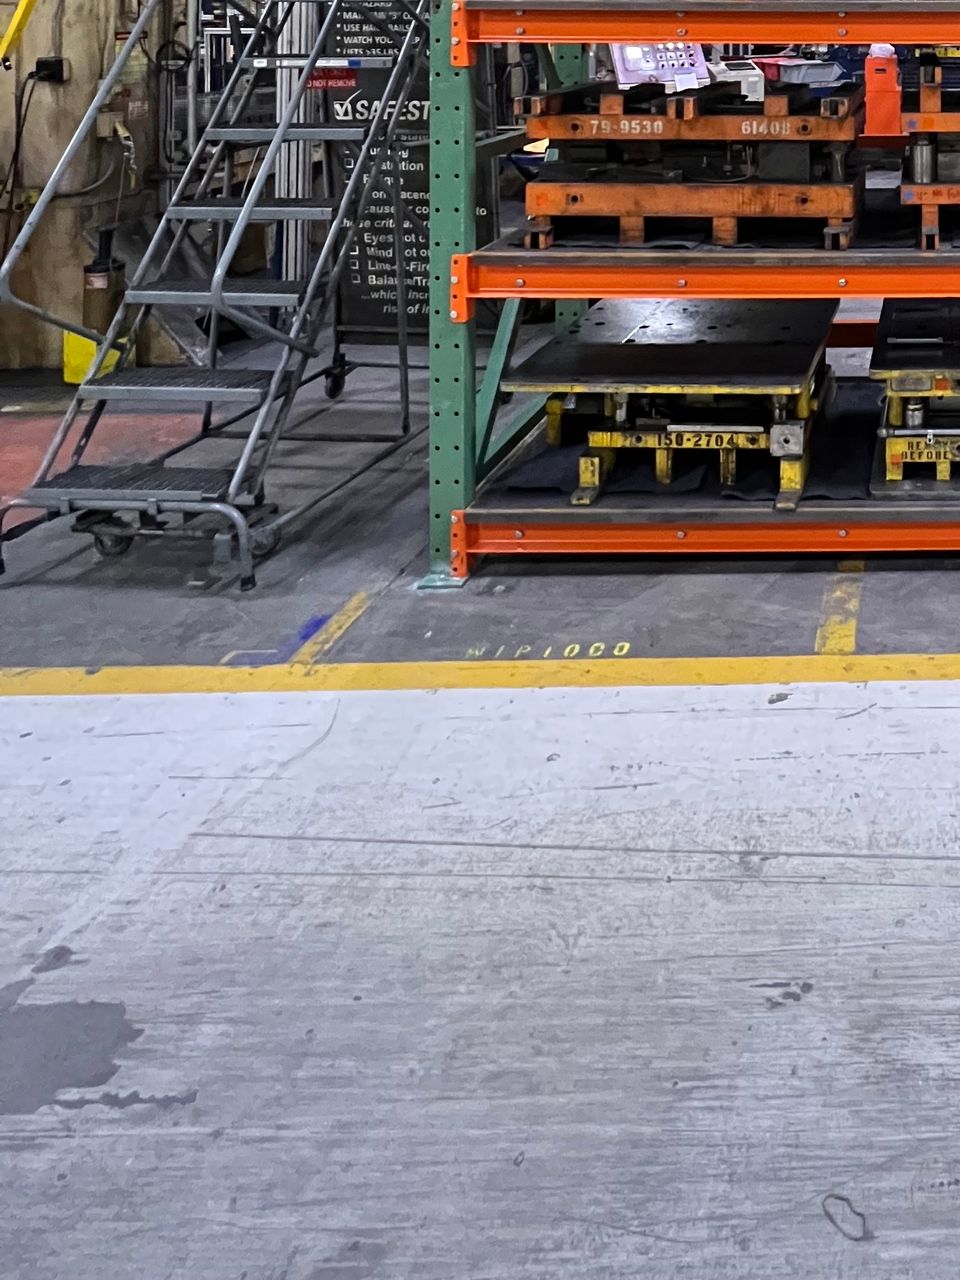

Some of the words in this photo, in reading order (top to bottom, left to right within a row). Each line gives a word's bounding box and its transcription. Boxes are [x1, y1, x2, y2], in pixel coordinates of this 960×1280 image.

[344, 24, 360, 32] USE
[343, 36, 373, 44] WATCH
[328, 79, 357, 87] REMOVE
[590, 120, 663, 134] 79-9530
[364, 233, 394, 245] Eyes
[366, 246, 393, 257] Mind
[407, 304, 420, 314] of
